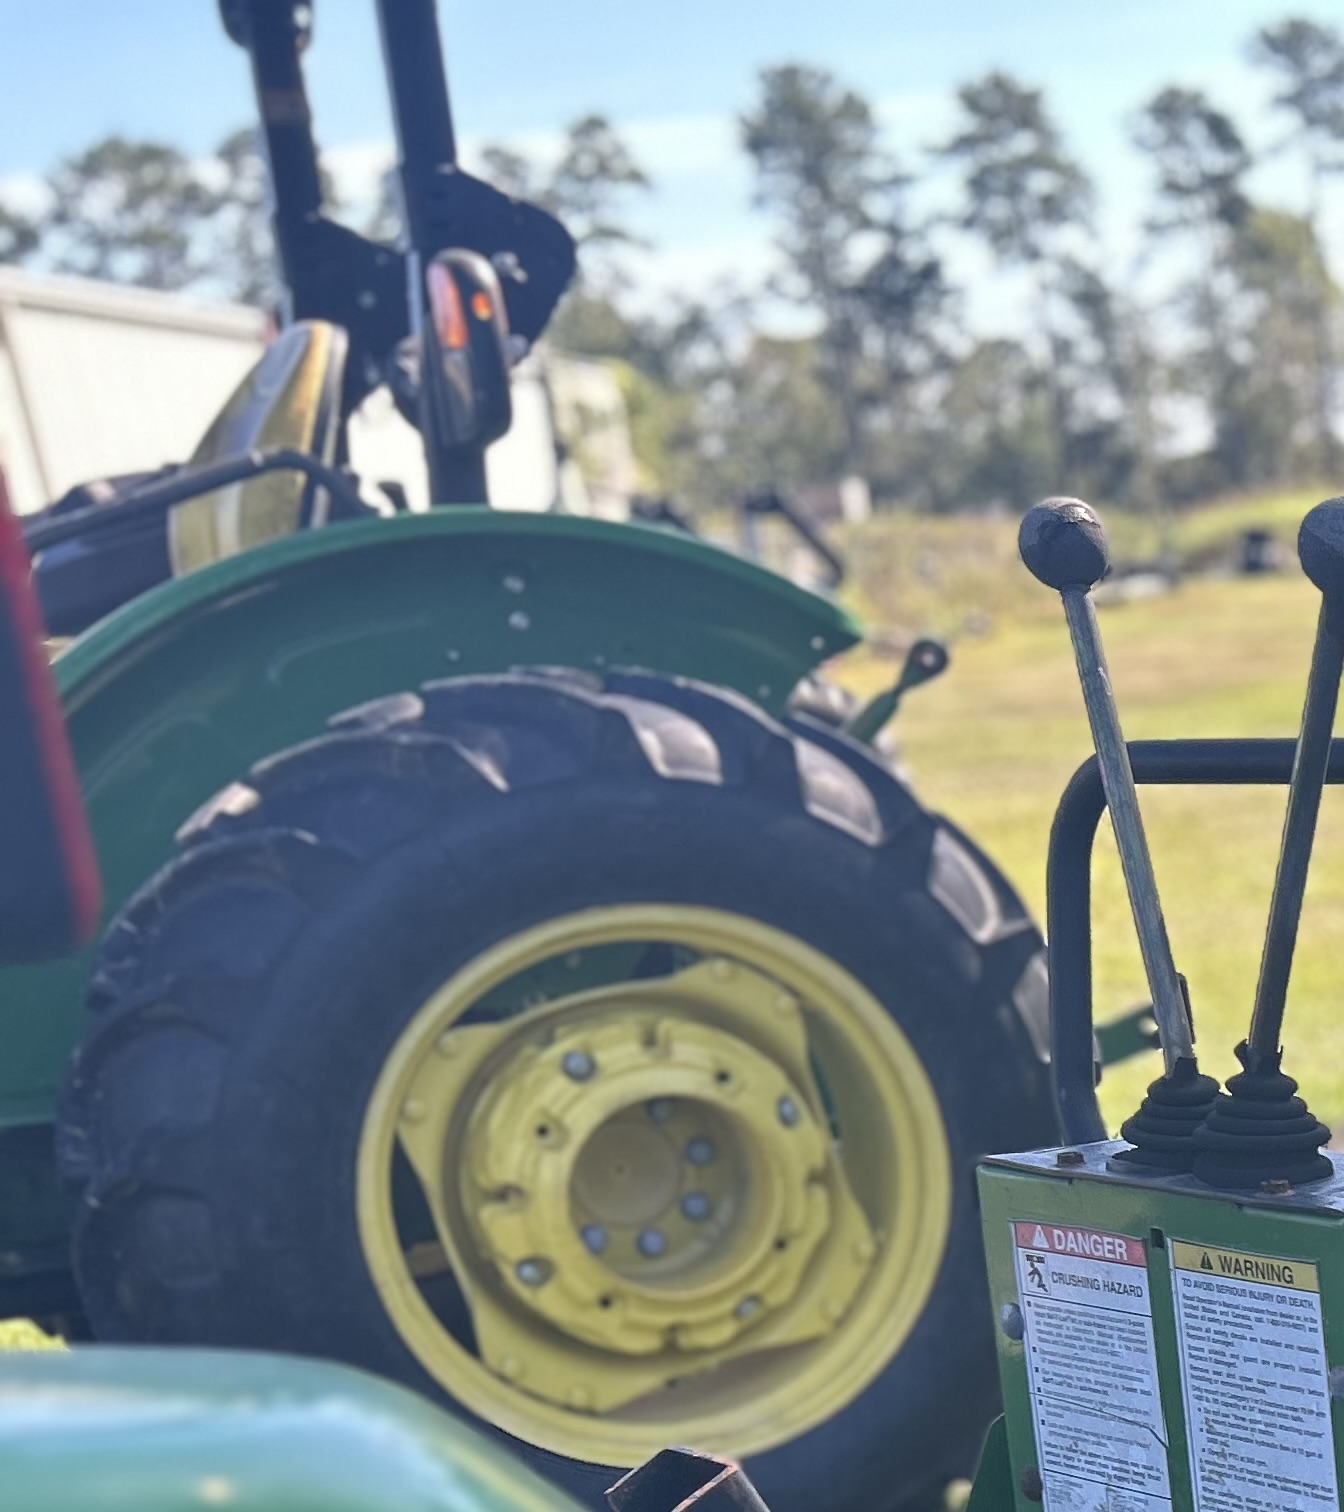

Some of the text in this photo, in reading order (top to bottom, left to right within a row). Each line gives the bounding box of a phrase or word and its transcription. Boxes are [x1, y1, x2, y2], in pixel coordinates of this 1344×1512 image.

[1052, 1228, 1128, 1261] DANGER
[1051, 1271, 1143, 1298] CRUSHING HAZARD
[1218, 1254, 1294, 1285] WARNING
